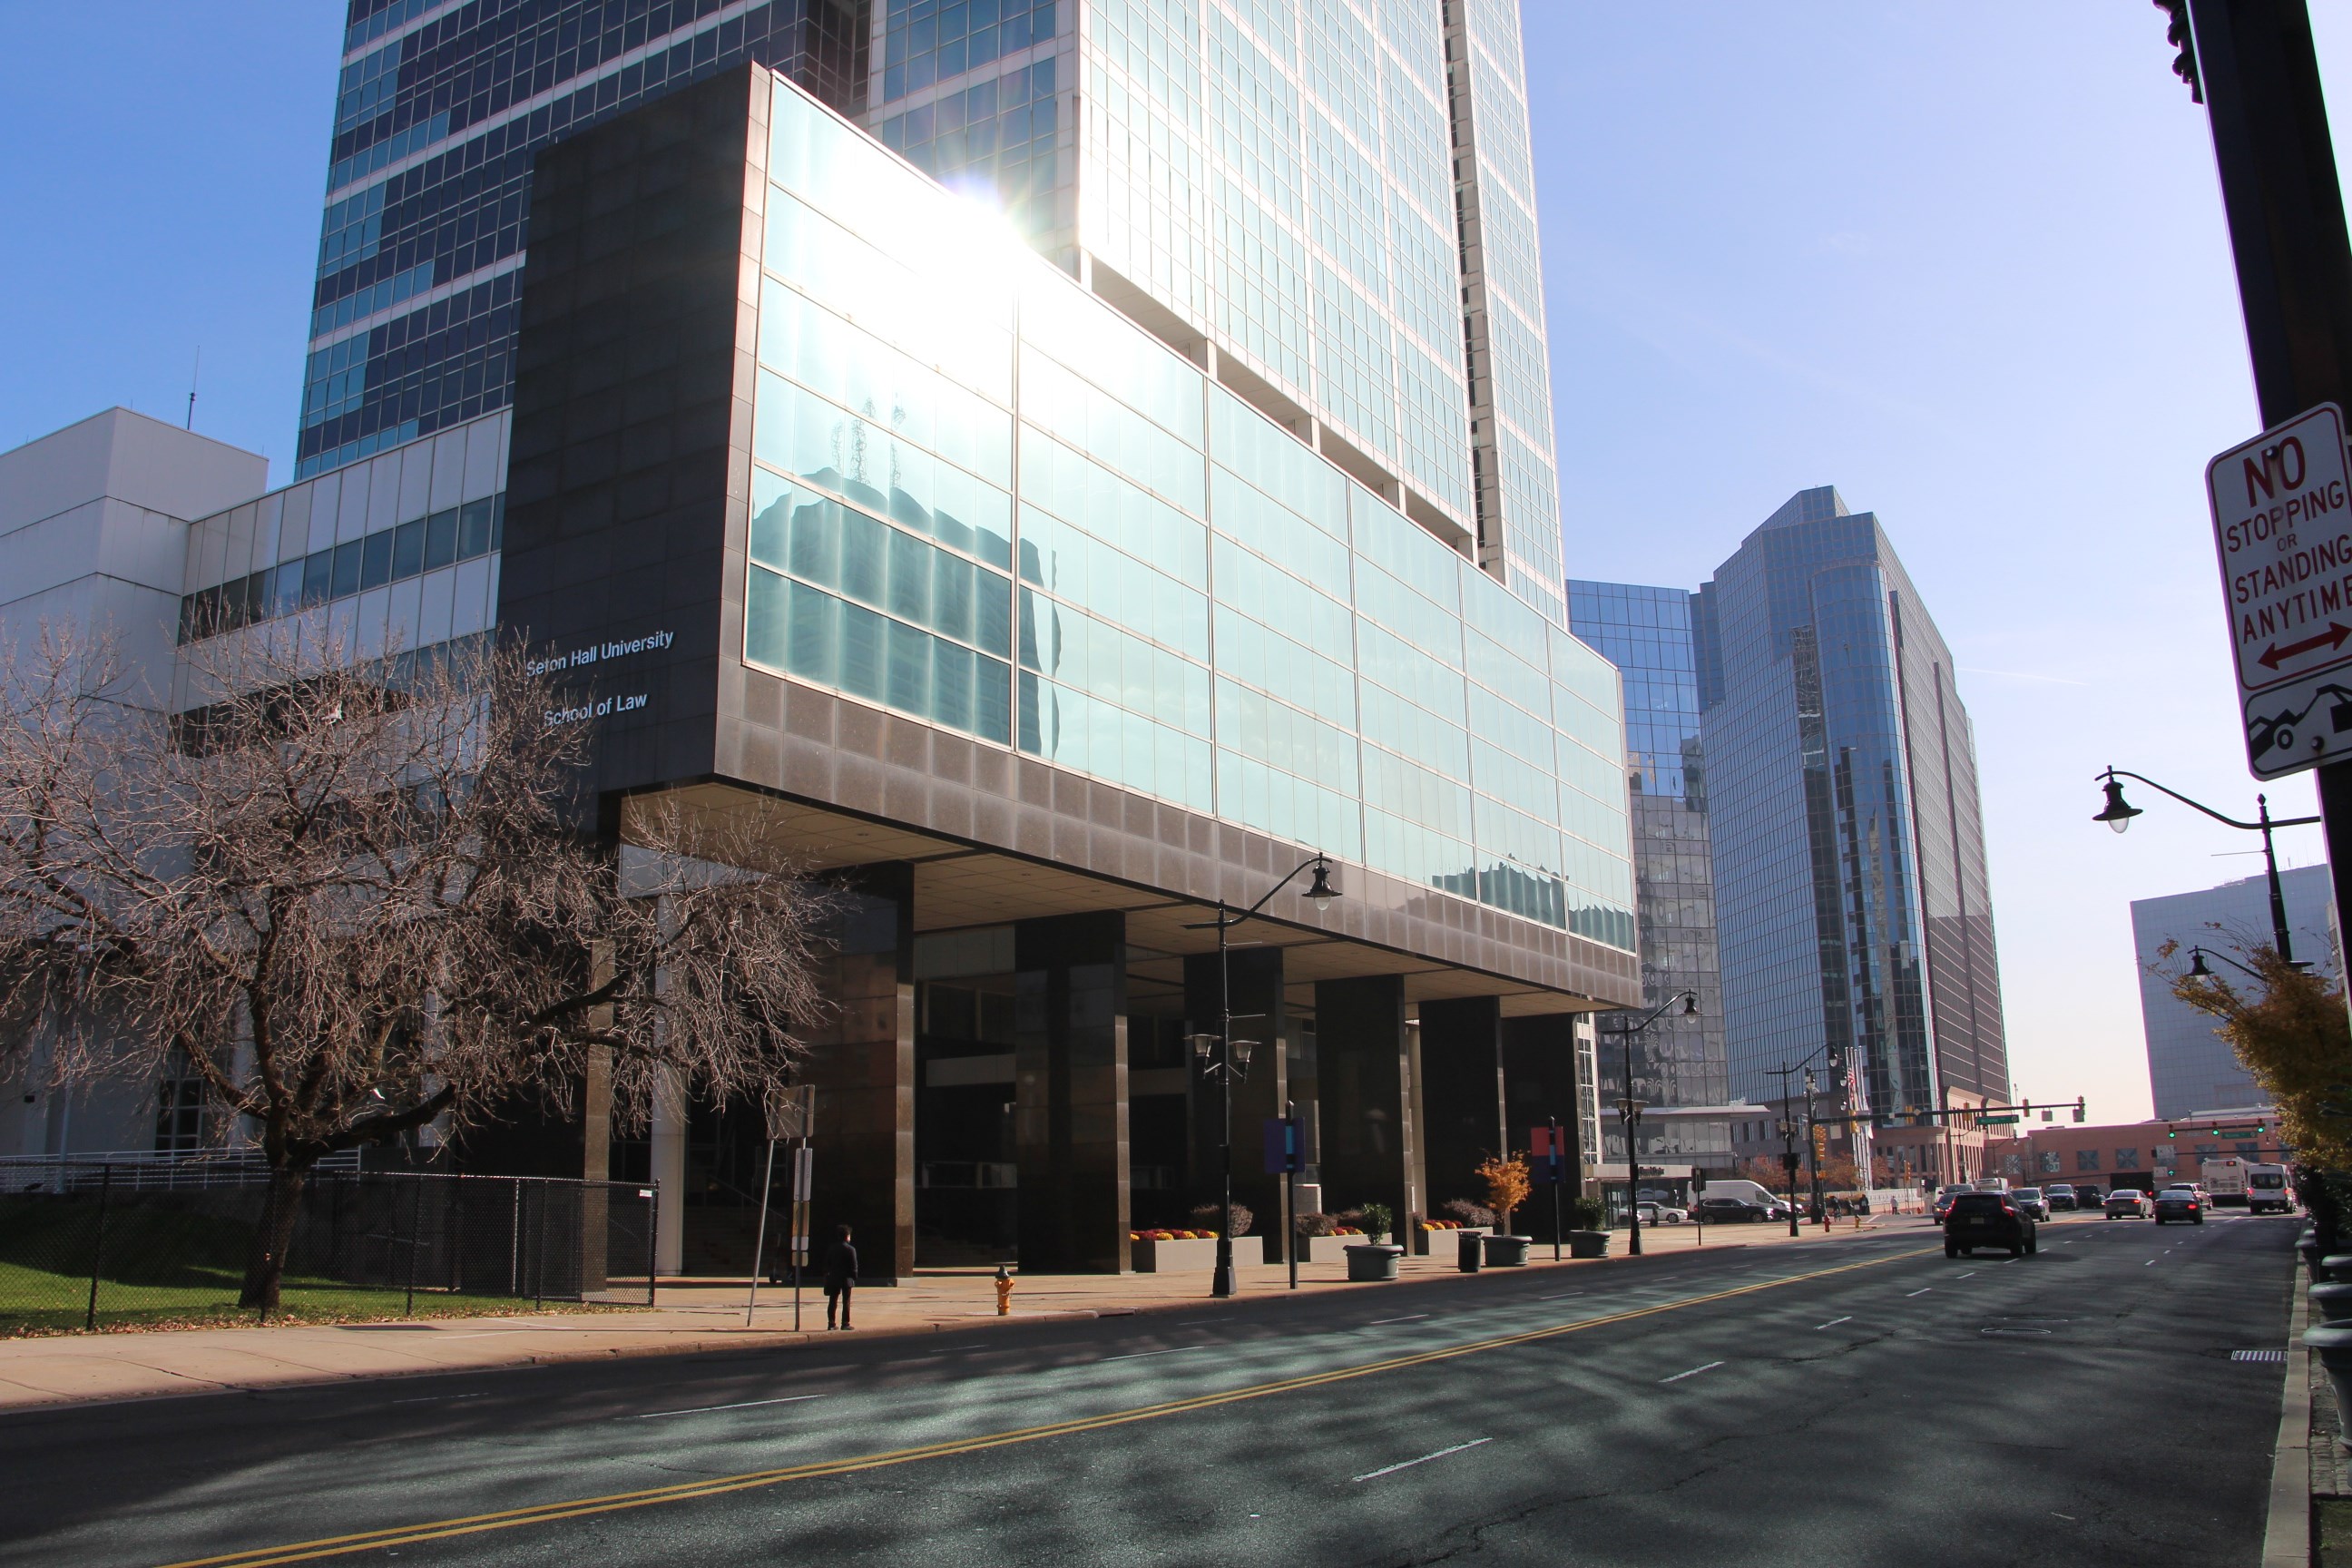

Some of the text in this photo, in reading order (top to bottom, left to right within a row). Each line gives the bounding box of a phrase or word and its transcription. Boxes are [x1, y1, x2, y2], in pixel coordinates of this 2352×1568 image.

[2243, 436, 2306, 508] NO
[2226, 480, 2345, 553] STOPPING
[2277, 533, 2298, 552] OR
[2235, 534, 2352, 604] STANDING
[526, 630, 673, 677] Seton Hall University
[544, 693, 648, 727] School of Law
